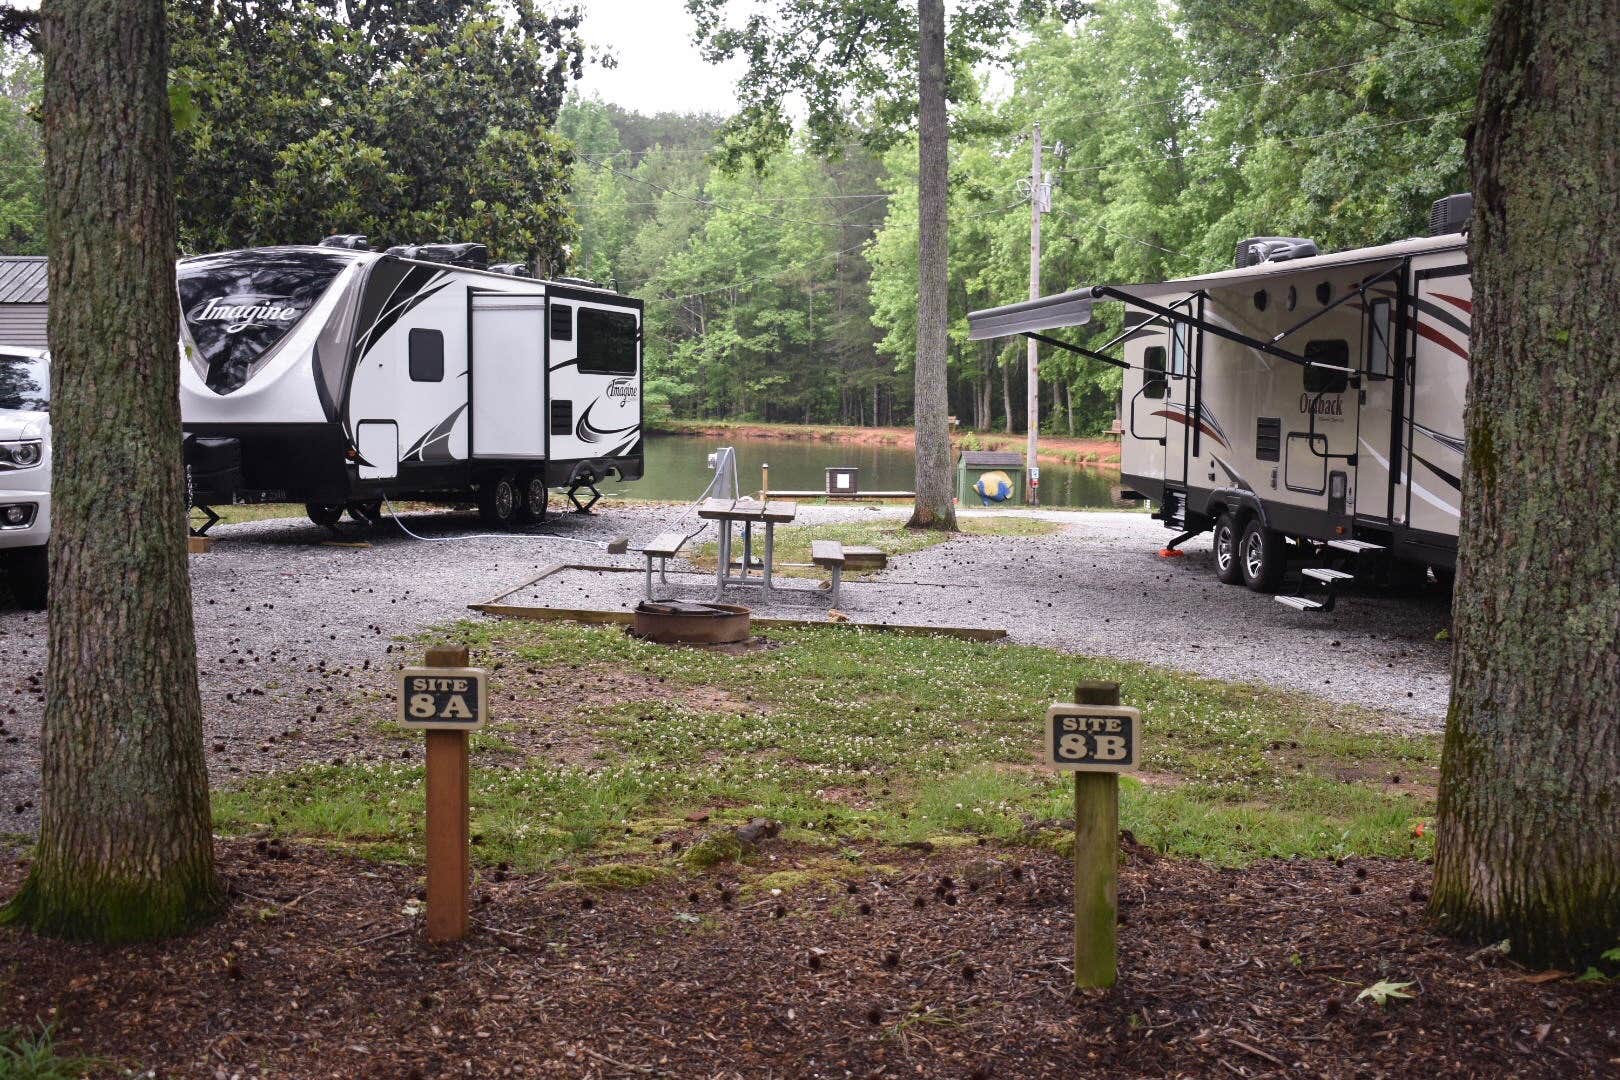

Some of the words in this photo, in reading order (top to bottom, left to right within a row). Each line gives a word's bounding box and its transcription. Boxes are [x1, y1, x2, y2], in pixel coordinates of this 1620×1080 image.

[195, 296, 295, 333] Imagine
[609, 378, 638, 407] Imagine
[412, 678, 469, 692] SITE
[409, 693, 473, 718] 8A
[1062, 717, 1122, 732] SITE
[1058, 733, 1127, 760] 8B
